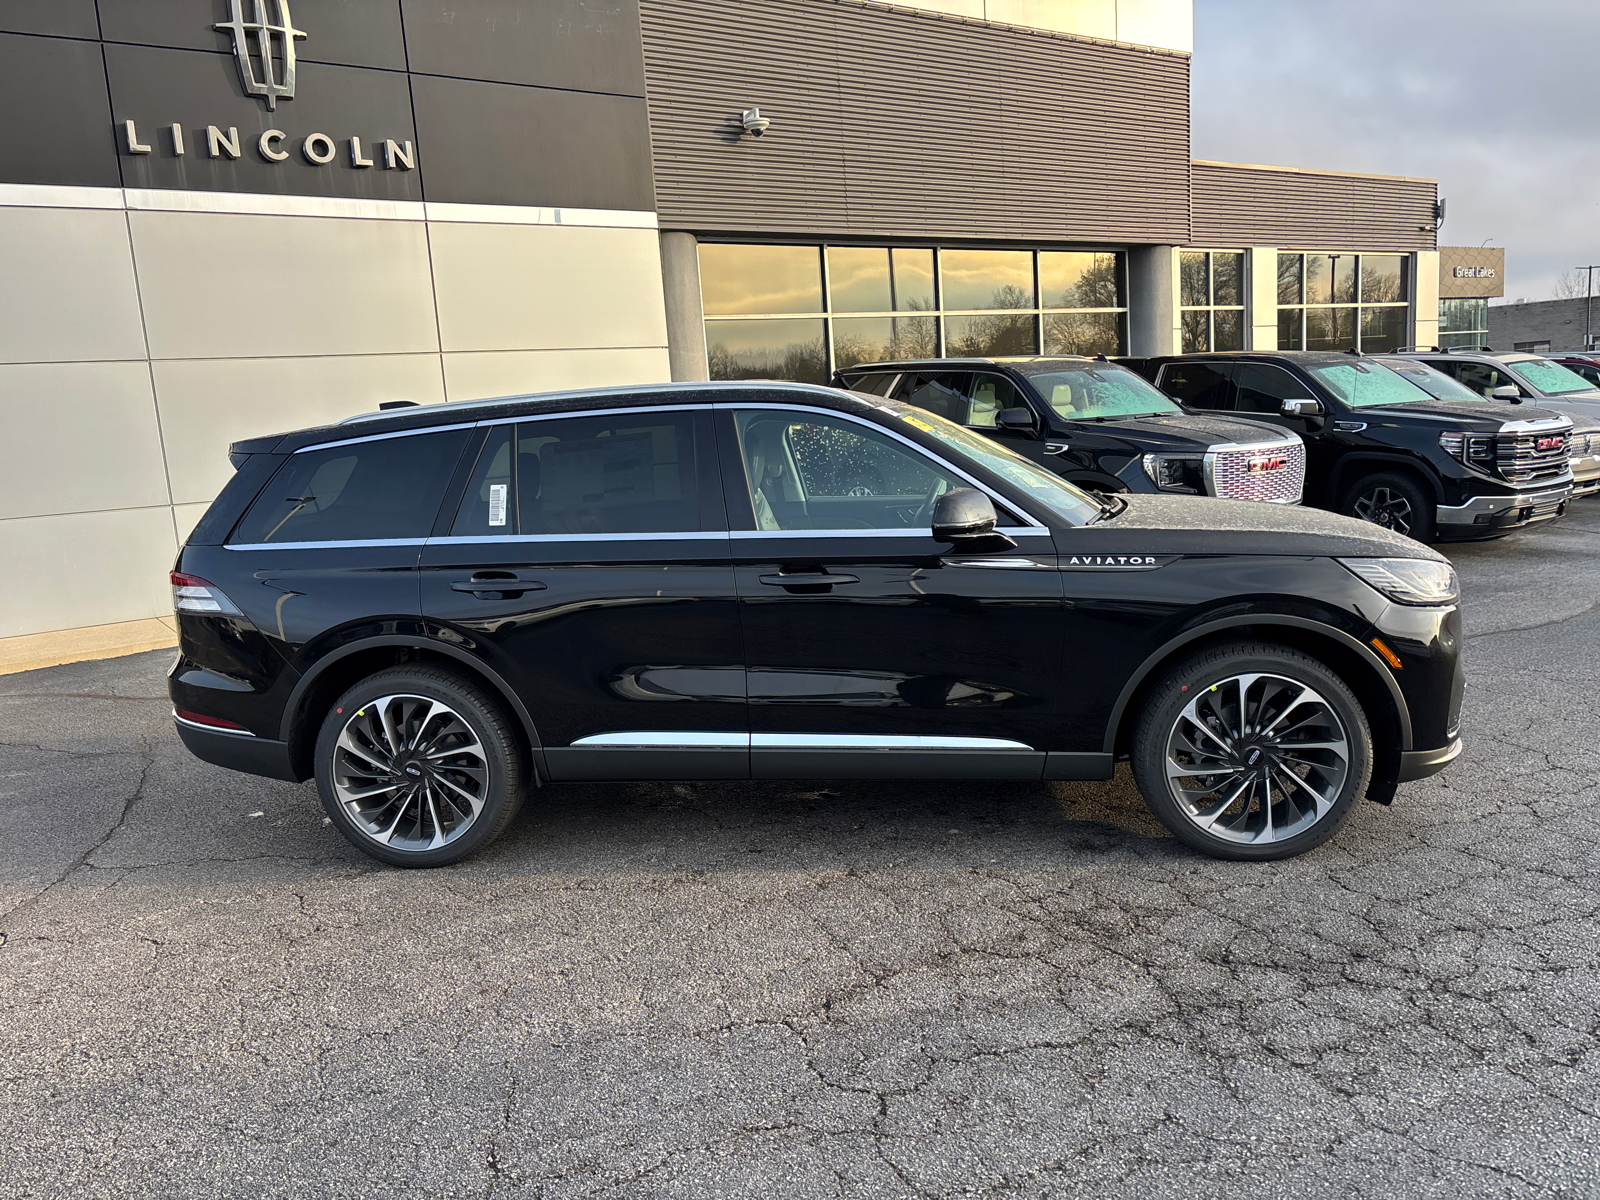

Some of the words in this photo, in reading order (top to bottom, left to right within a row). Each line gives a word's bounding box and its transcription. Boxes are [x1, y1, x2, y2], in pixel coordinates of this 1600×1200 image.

[124, 119, 415, 170] LINCOLN
[1456, 266, 1475, 278] Great
[1476, 266, 1495, 278] Lakes
[1538, 437, 1564, 450] GMC
[1248, 457, 1287, 472] GMC
[1069, 556, 1156, 565] AVIATOR
[1311, 757, 1365, 843] GOODYEAR
